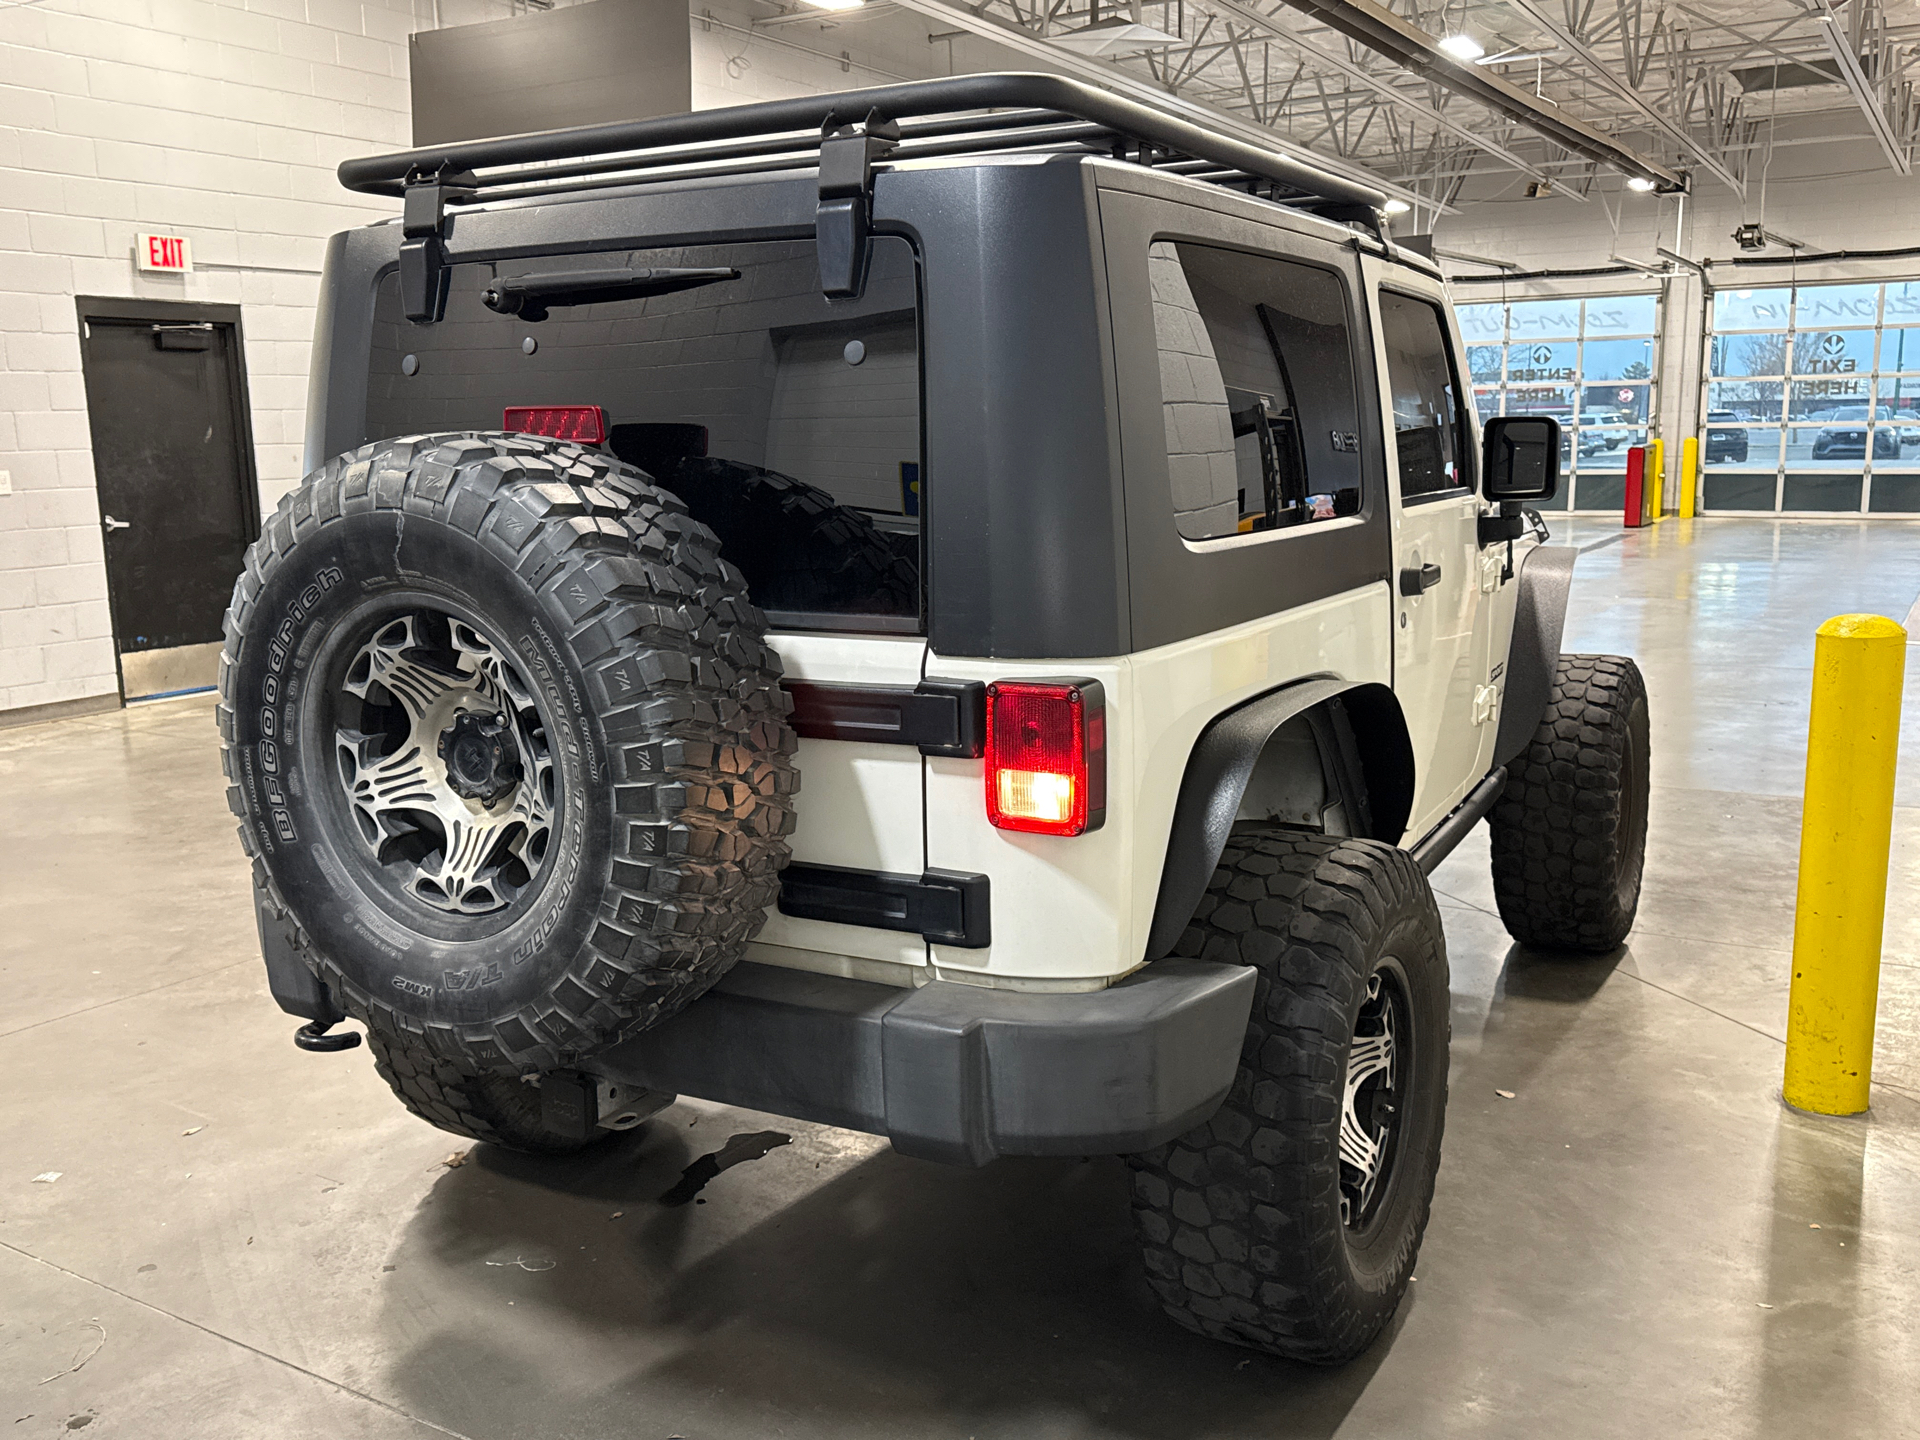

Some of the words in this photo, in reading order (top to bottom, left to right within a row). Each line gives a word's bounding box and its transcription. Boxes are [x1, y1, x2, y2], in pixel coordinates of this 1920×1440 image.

[149, 236, 184, 269] EXIT
[504, 515, 525, 534] T/A
[569, 583, 588, 606] T/A
[613, 668, 632, 691] T/A
[259, 566, 344, 843] BFGoodrich
[636, 749, 652, 771] T/A
[641, 830, 656, 852] T/A
[628, 904, 644, 924] T/A
[392, 975, 434, 998] KM2
[443, 961, 504, 991] T/A
[600, 971, 616, 988] T/A
[550, 1022, 568, 1036] T/A
